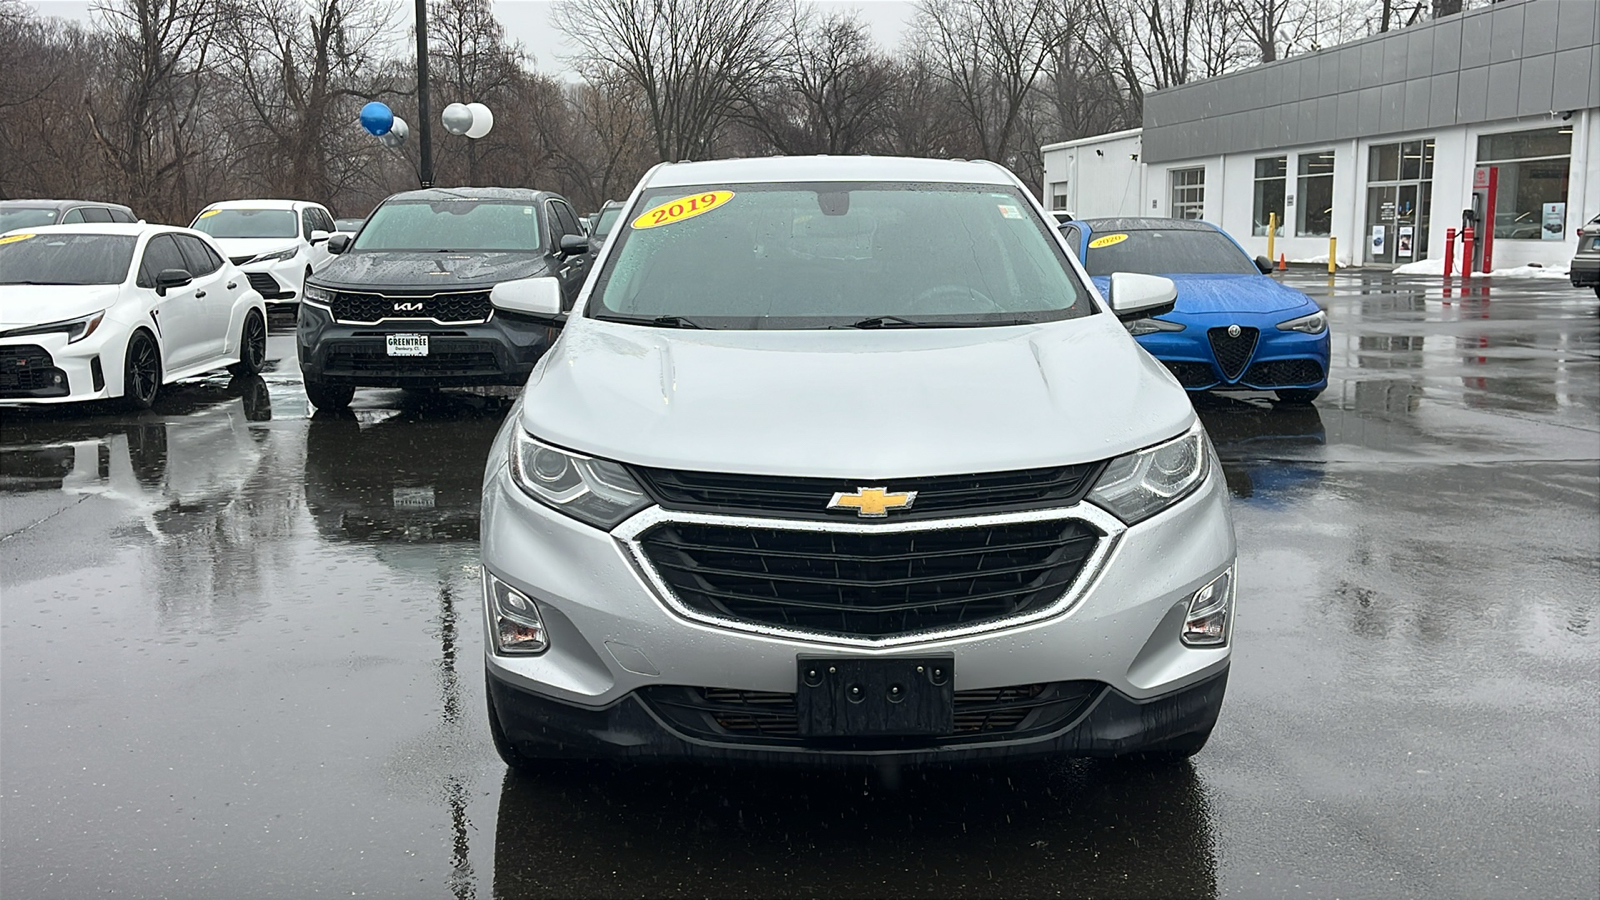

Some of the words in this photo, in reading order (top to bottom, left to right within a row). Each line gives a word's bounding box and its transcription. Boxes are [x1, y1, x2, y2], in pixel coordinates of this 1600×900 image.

[652, 193, 717, 224] 2019
[1096, 235, 1122, 247] 2020
[394, 302, 423, 311] KIA
[388, 338, 427, 346] GREENTREE
